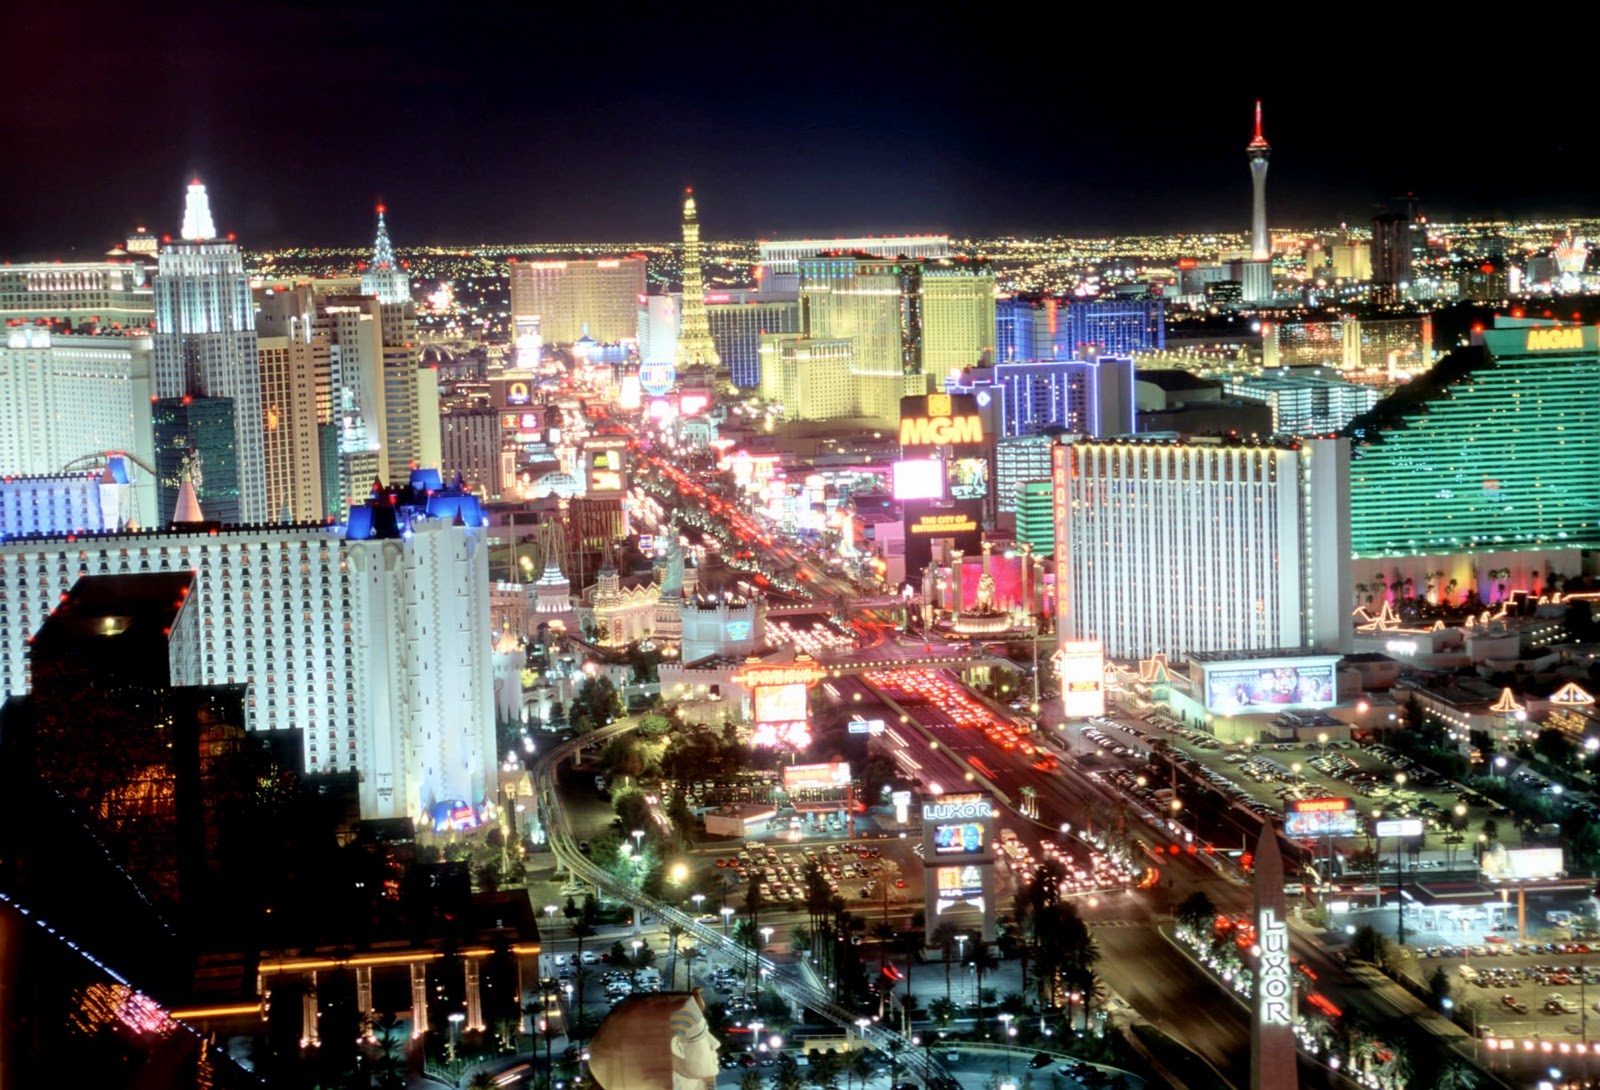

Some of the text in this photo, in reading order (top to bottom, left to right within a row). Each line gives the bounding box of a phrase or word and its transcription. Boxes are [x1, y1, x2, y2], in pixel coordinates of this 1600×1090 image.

[1527, 328, 1584, 350] MGM
[900, 416, 983, 445] MGM
[911, 522, 977, 533] ENTERTAINMENT
[921, 515, 967, 525] THE CITY OF
[1055, 449, 1068, 616] TROPICANA
[924, 803, 993, 819] LUXOR
[1297, 801, 1346, 812] TROPICANA
[1261, 910, 1291, 1024] LUXOR
